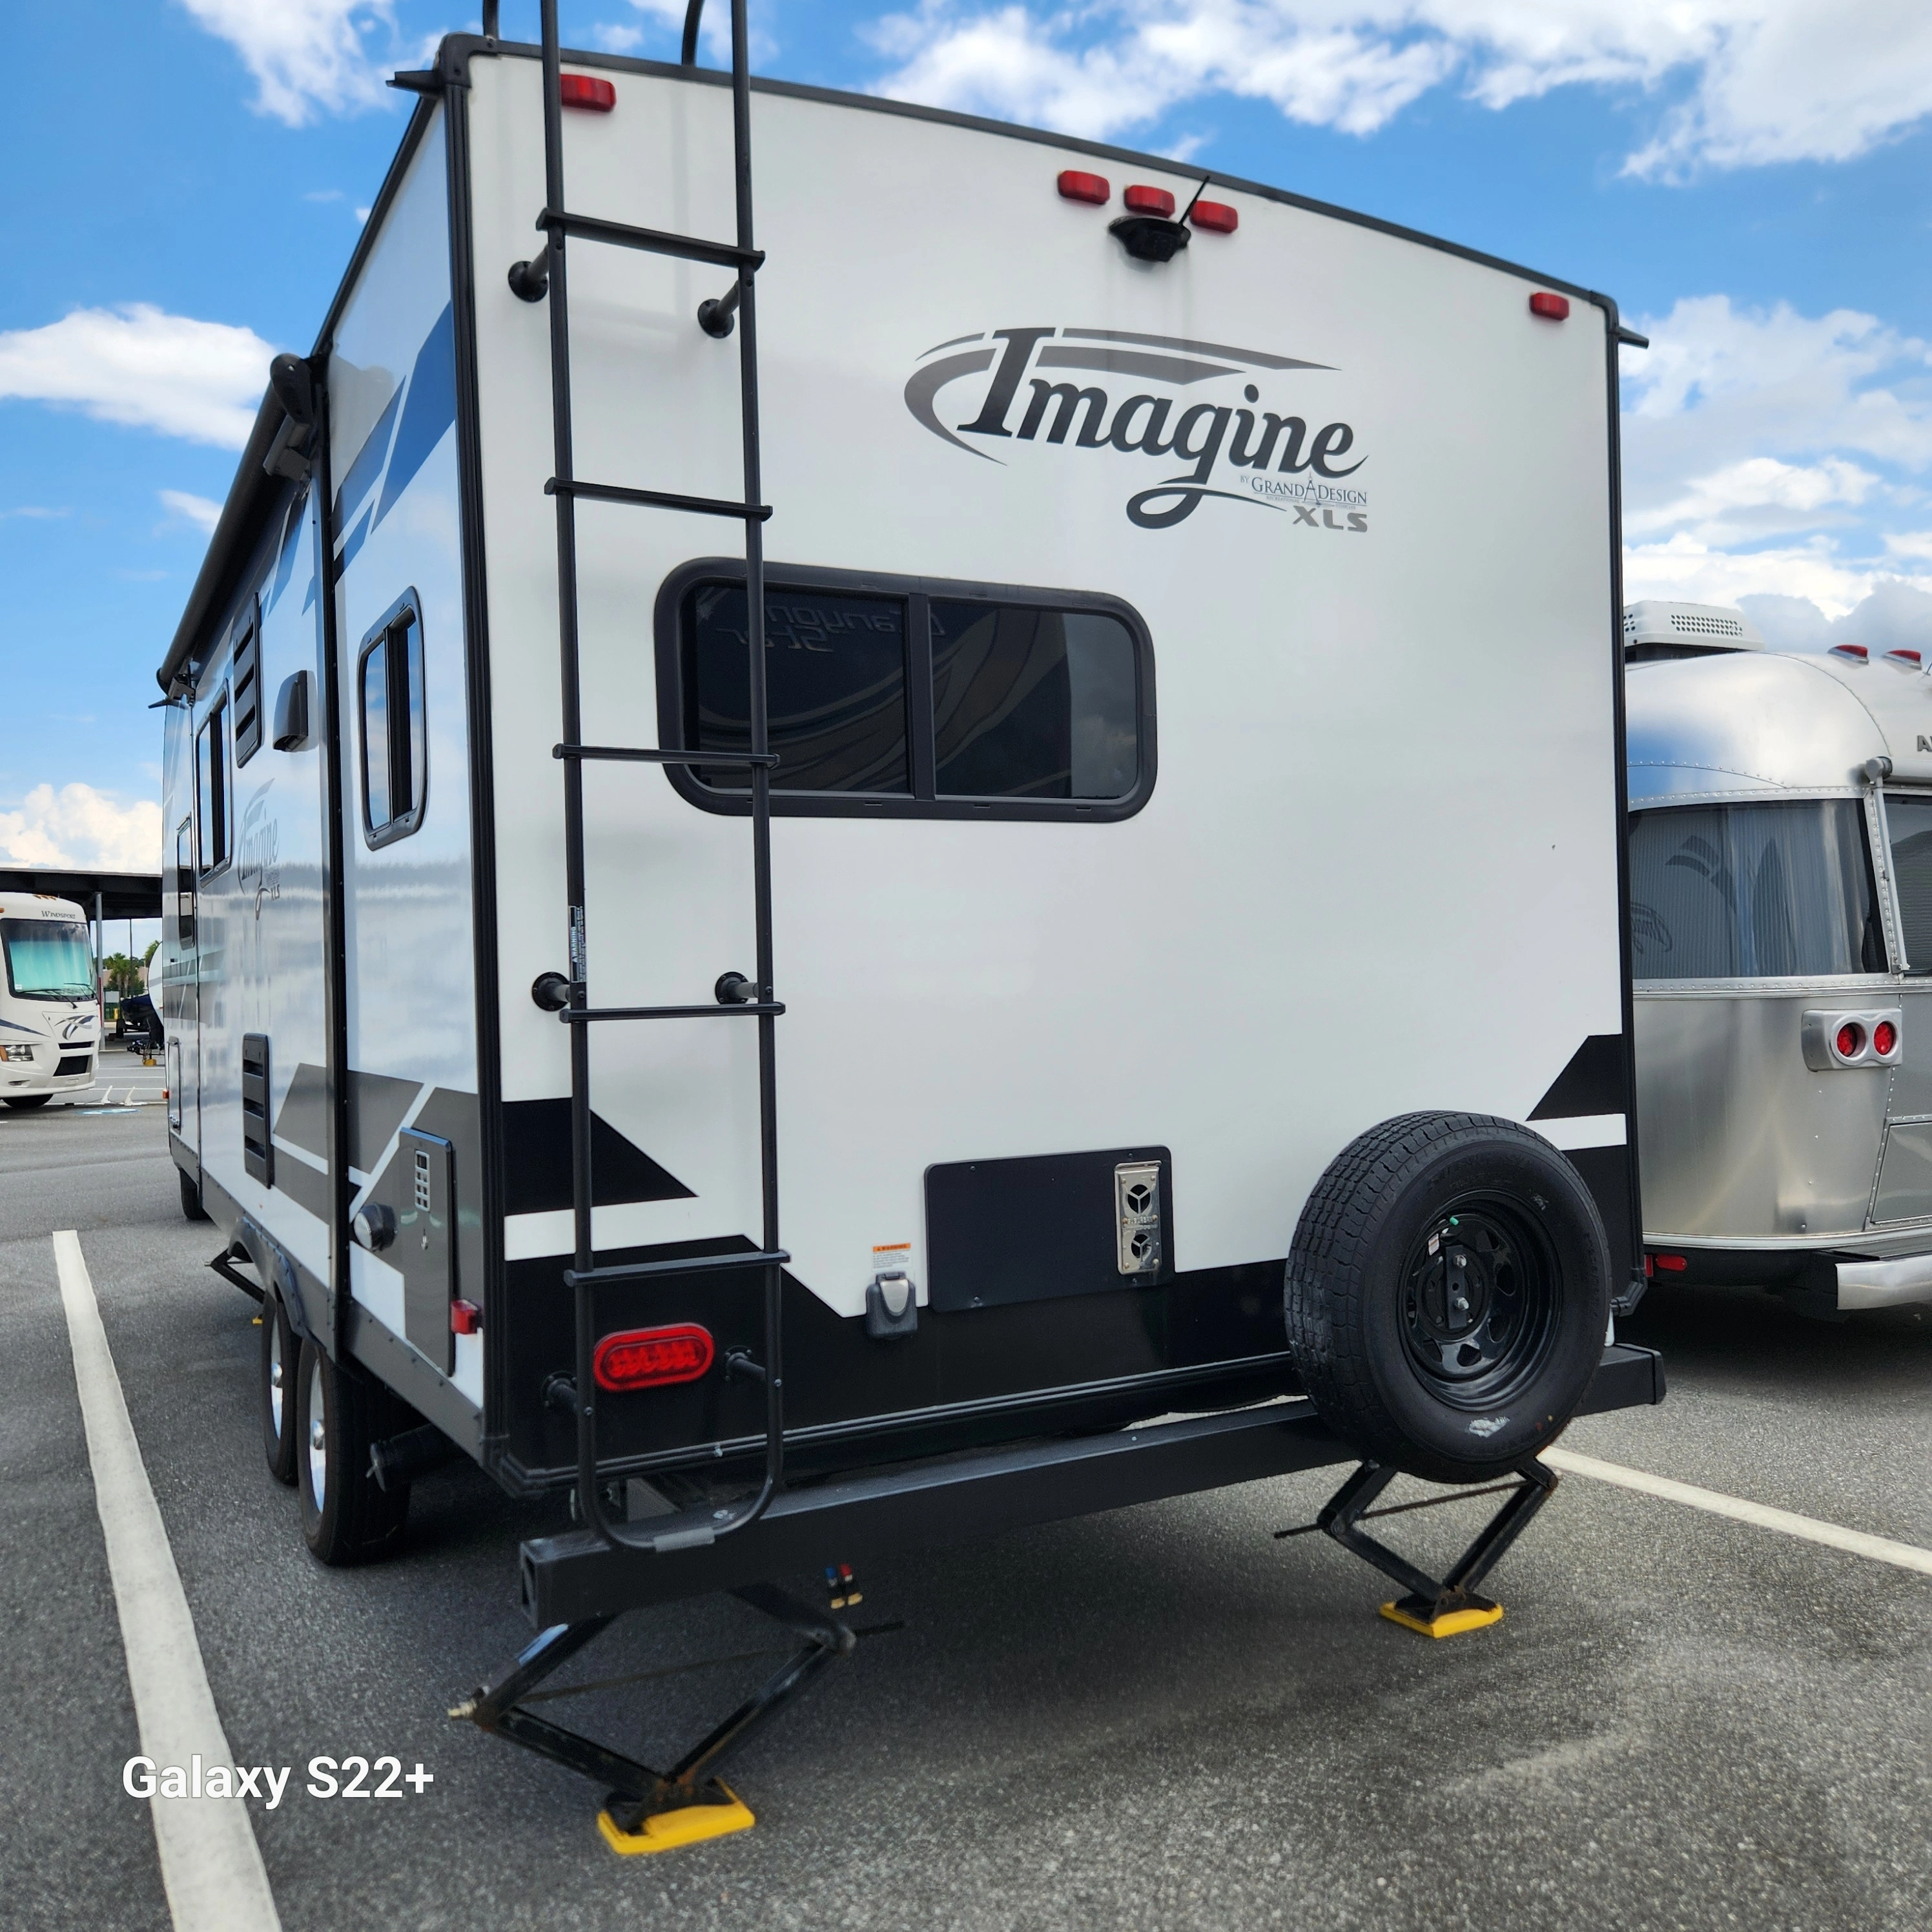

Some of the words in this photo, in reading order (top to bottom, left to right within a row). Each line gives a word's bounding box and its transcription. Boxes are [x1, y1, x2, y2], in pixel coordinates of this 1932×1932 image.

[957, 327, 1369, 529] Imagine
[1240, 475, 1250, 484] BY
[1251, 477, 1304, 497] GRAND
[1318, 484, 1367, 504] DESIGN
[1292, 506, 1368, 533] XLS
[241, 807, 280, 921] Imagine
